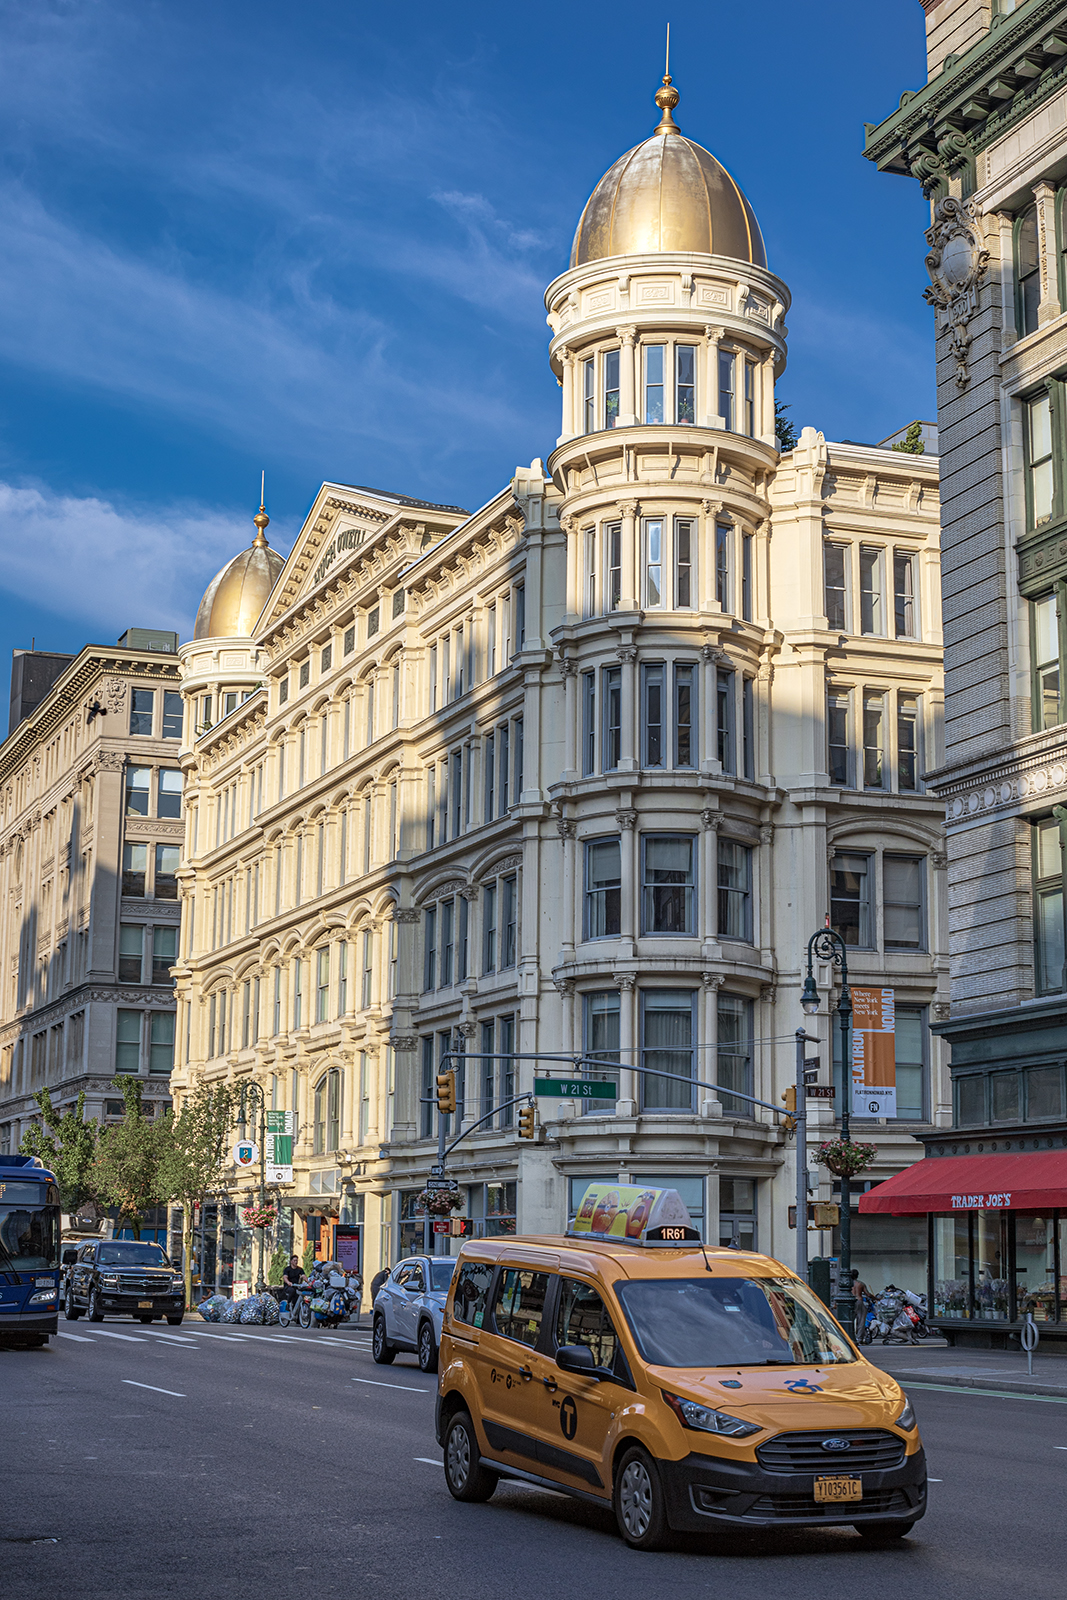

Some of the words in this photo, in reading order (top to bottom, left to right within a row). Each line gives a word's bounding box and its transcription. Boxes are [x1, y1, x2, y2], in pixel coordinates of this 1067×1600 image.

[881, 988, 895, 1033] NOMAD
[852, 1028, 865, 1086] FLATIRON
[560, 1084, 568, 1094] W
[571, 1084, 580, 1094] 21
[582, 1084, 592, 1096] St
[810, 1088, 816, 1096] W
[818, 1088, 824, 1096] 21
[826, 1088, 834, 1097] St
[285, 1110, 293, 1136] NOMAD
[266, 1132, 274, 1164] FLATIRON
[951, 1195, 984, 1208] TRADER
[986, 1193, 1012, 1207] JOE'S
[661, 1228, 685, 1240] 1R61
[818, 1482, 858, 1496] Y103561C
